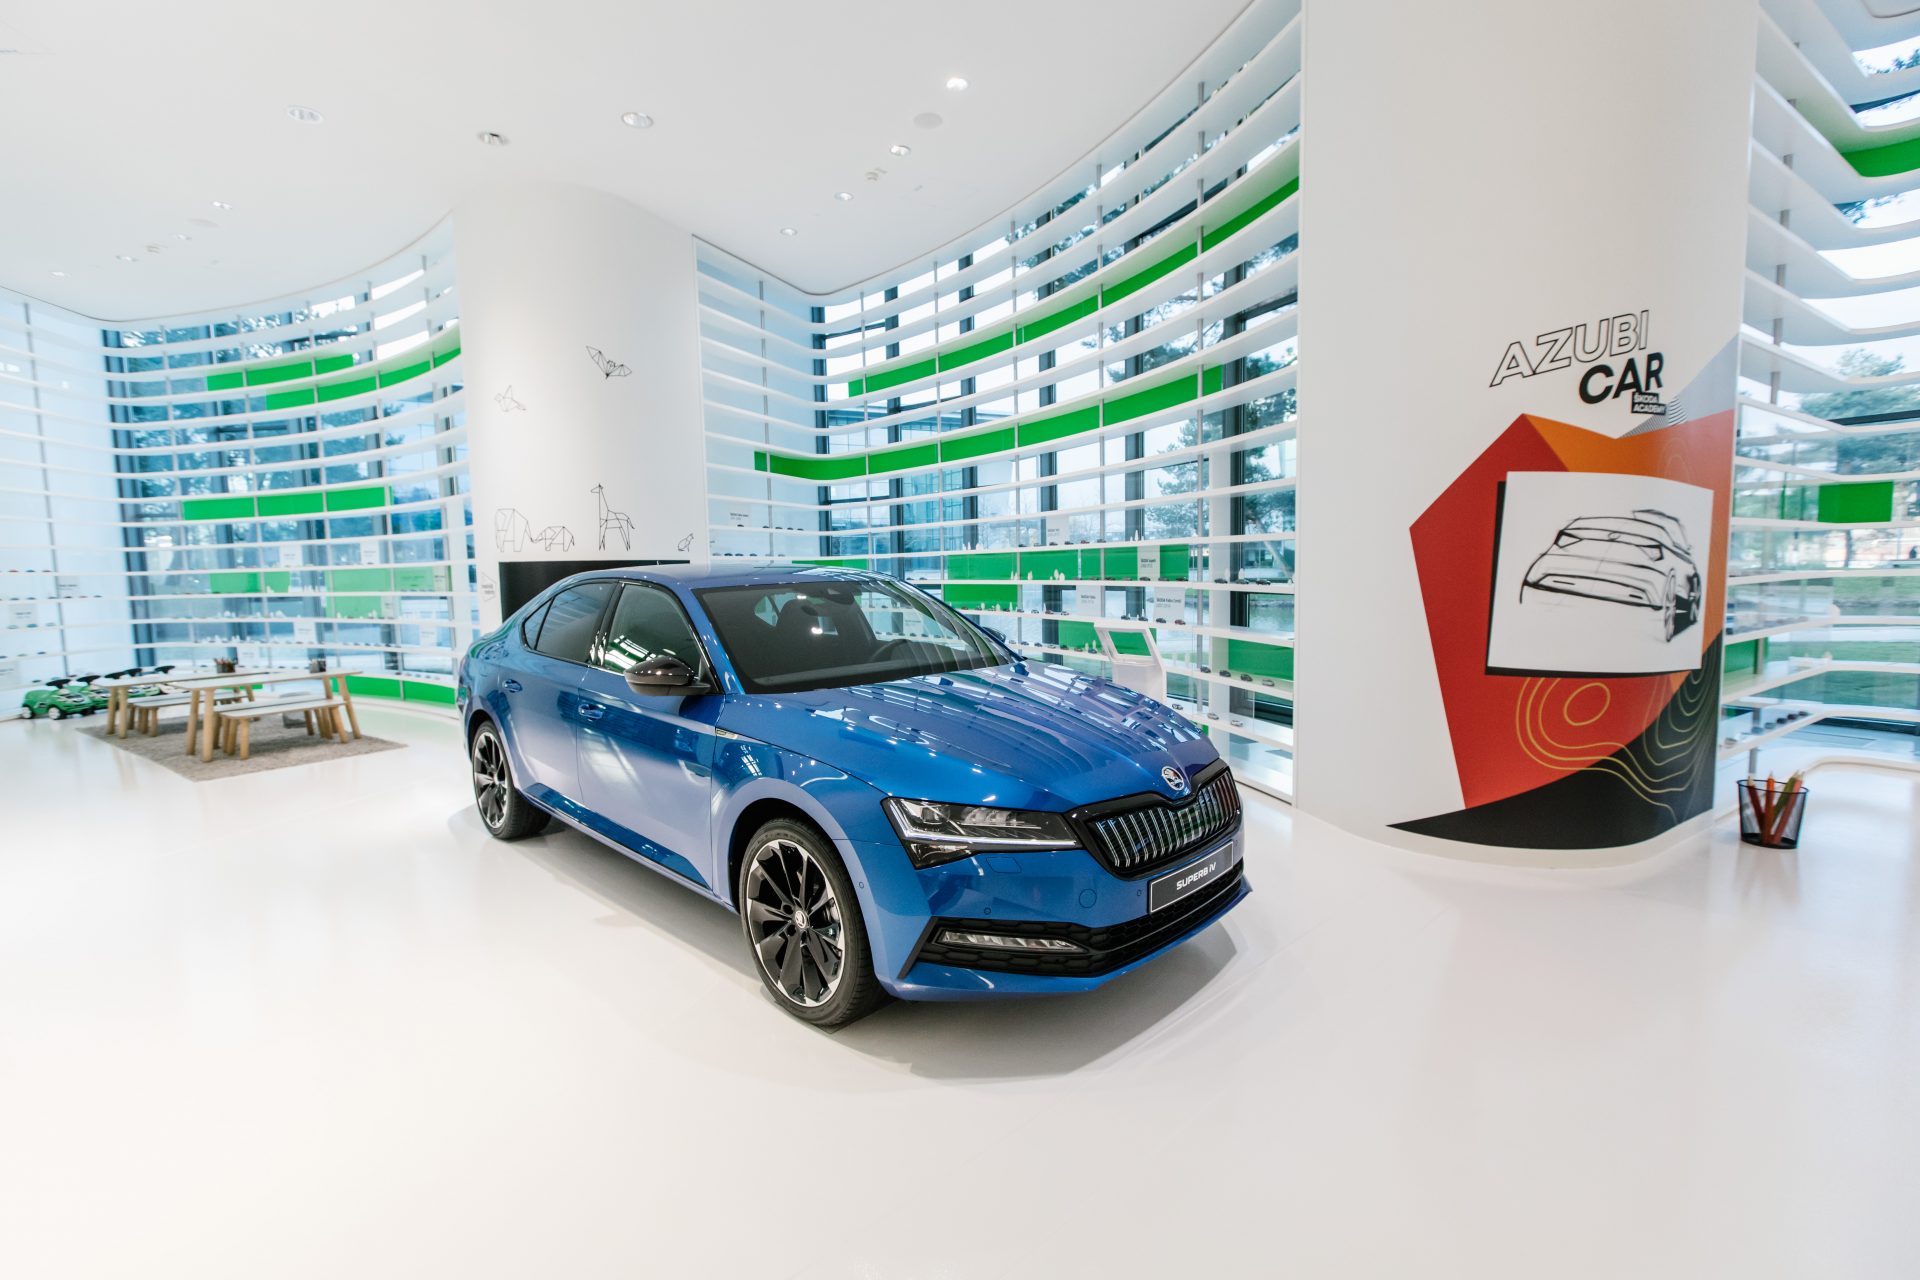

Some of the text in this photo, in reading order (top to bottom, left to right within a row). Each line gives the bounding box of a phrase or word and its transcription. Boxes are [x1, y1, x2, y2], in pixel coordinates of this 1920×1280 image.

[1489, 310, 1649, 387] AZUBI
[1579, 351, 1664, 404] CAR
[1633, 404, 1665, 413] ACADEMY
[1176, 867, 1208, 890] SUPERB
